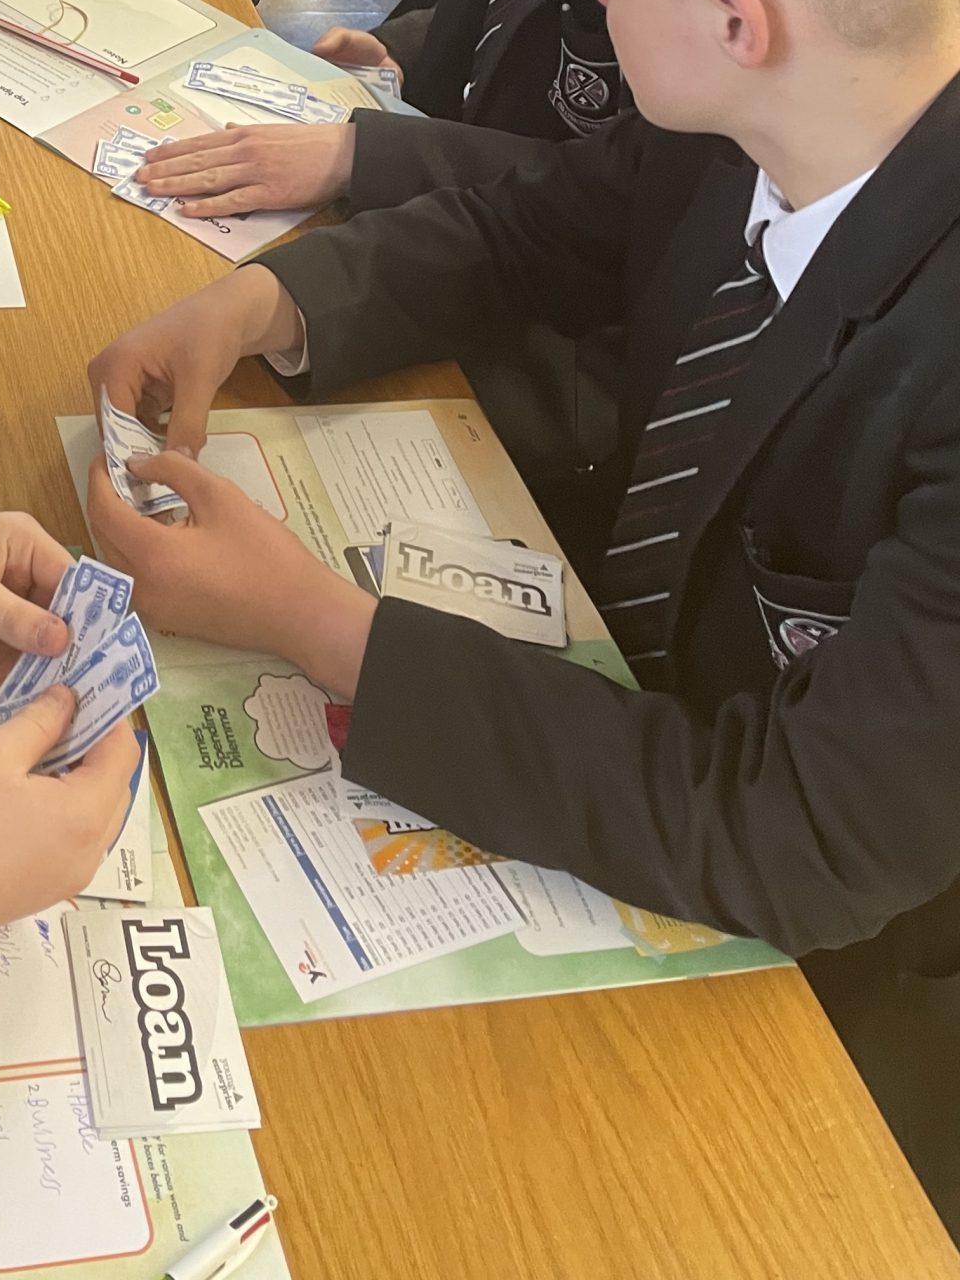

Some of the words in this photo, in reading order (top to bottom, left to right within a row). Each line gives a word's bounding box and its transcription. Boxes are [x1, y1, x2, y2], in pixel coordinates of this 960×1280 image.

[13, 92, 30, 106] Top
[114, 585, 125, 609] 100
[398, 543, 552, 618] Loan
[130, 674, 155, 698] 100
[186, 726, 213, 769] James'
[201, 705, 228, 769] Spending
[217, 709, 244, 768] Dilemma
[121, 919, 203, 1111] Loan
[211, 1058, 235, 1111] enterprise
[218, 1058, 237, 1093] young
[143, 1143, 158, 1171] boxes
[156, 1142, 169, 1157] for
[113, 1164, 135, 1208] savings
[150, 1172, 167, 1204] below.
[160, 1158, 176, 1192] various
[169, 1193, 183, 1221] wants
[176, 1222, 189, 1243] and
